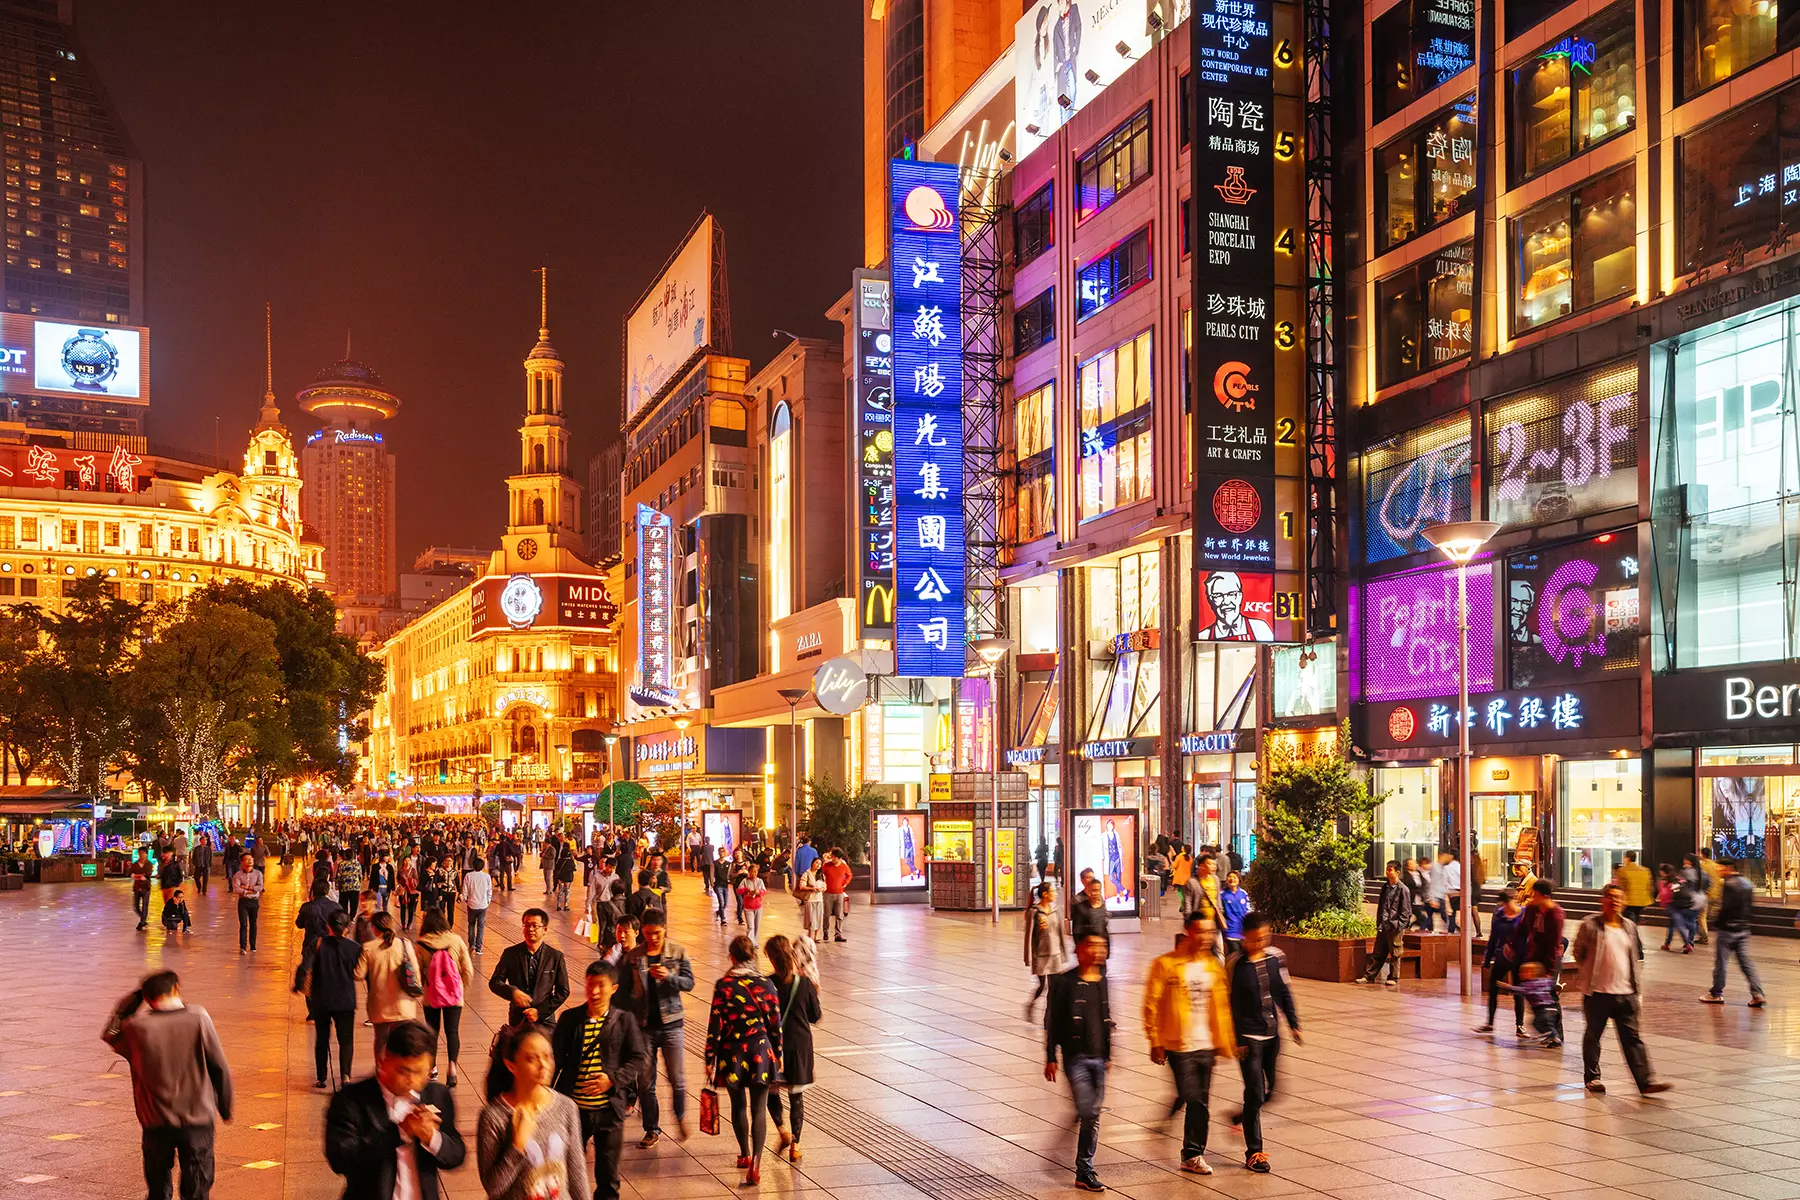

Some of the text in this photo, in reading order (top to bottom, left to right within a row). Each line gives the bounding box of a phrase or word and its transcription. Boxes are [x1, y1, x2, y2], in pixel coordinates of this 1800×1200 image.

[1215, 0, 1256, 19] 新世界
[1202, 13, 1269, 37] 现代珍藏品
[1222, 33, 1249, 50] 中心
[1201, 47, 1240, 62] NEW WORLD
[1275, 38, 1294, 68] 6
[1201, 59, 1269, 77] CONTEMPORARY ART
[1201, 71, 1228, 83] CENTER
[1208, 96, 1265, 132] 陶瓷
[1208, 135, 1260, 156] 精品商场
[1274, 131, 1295, 162] 5
[1208, 212, 1250, 231] SHANGHAI
[1208, 230, 1256, 250] PORCELAIN
[1275, 228, 1296, 256] 4
[1208, 249, 1231, 266] EXPO
[1207, 293, 1266, 320] 珍珠城
[1206, 321, 1260, 341] PEARLS CITY
[1274, 320, 1296, 352] 3
[864, 377, 874, 385] 5F
[1232, 383, 1260, 392] PEARLS
[334, 428, 375, 444] Radisson
[863, 429, 874, 437] 4F
[1207, 425, 1267, 445] 工艺礼品
[1275, 416, 1297, 448] 2
[911, 256, 951, 651] 江蘇陽光集團公司
[1207, 447, 1262, 461] ART & CRAFTS
[1279, 511, 1294, 540] 1
[1203, 536, 1271, 553] 新世界銀樓
[1204, 552, 1271, 563] New World Jewelers
[1244, 600, 1273, 613] KFC
[1274, 592, 1304, 621] B1
[797, 631, 822, 652] ZARA
[1726, 677, 1800, 720] Ber
[1084, 740, 1130, 758] ME&CITY
[1181, 732, 1236, 756] ME&CITY
[1006, 747, 1043, 764] ME&CITY
